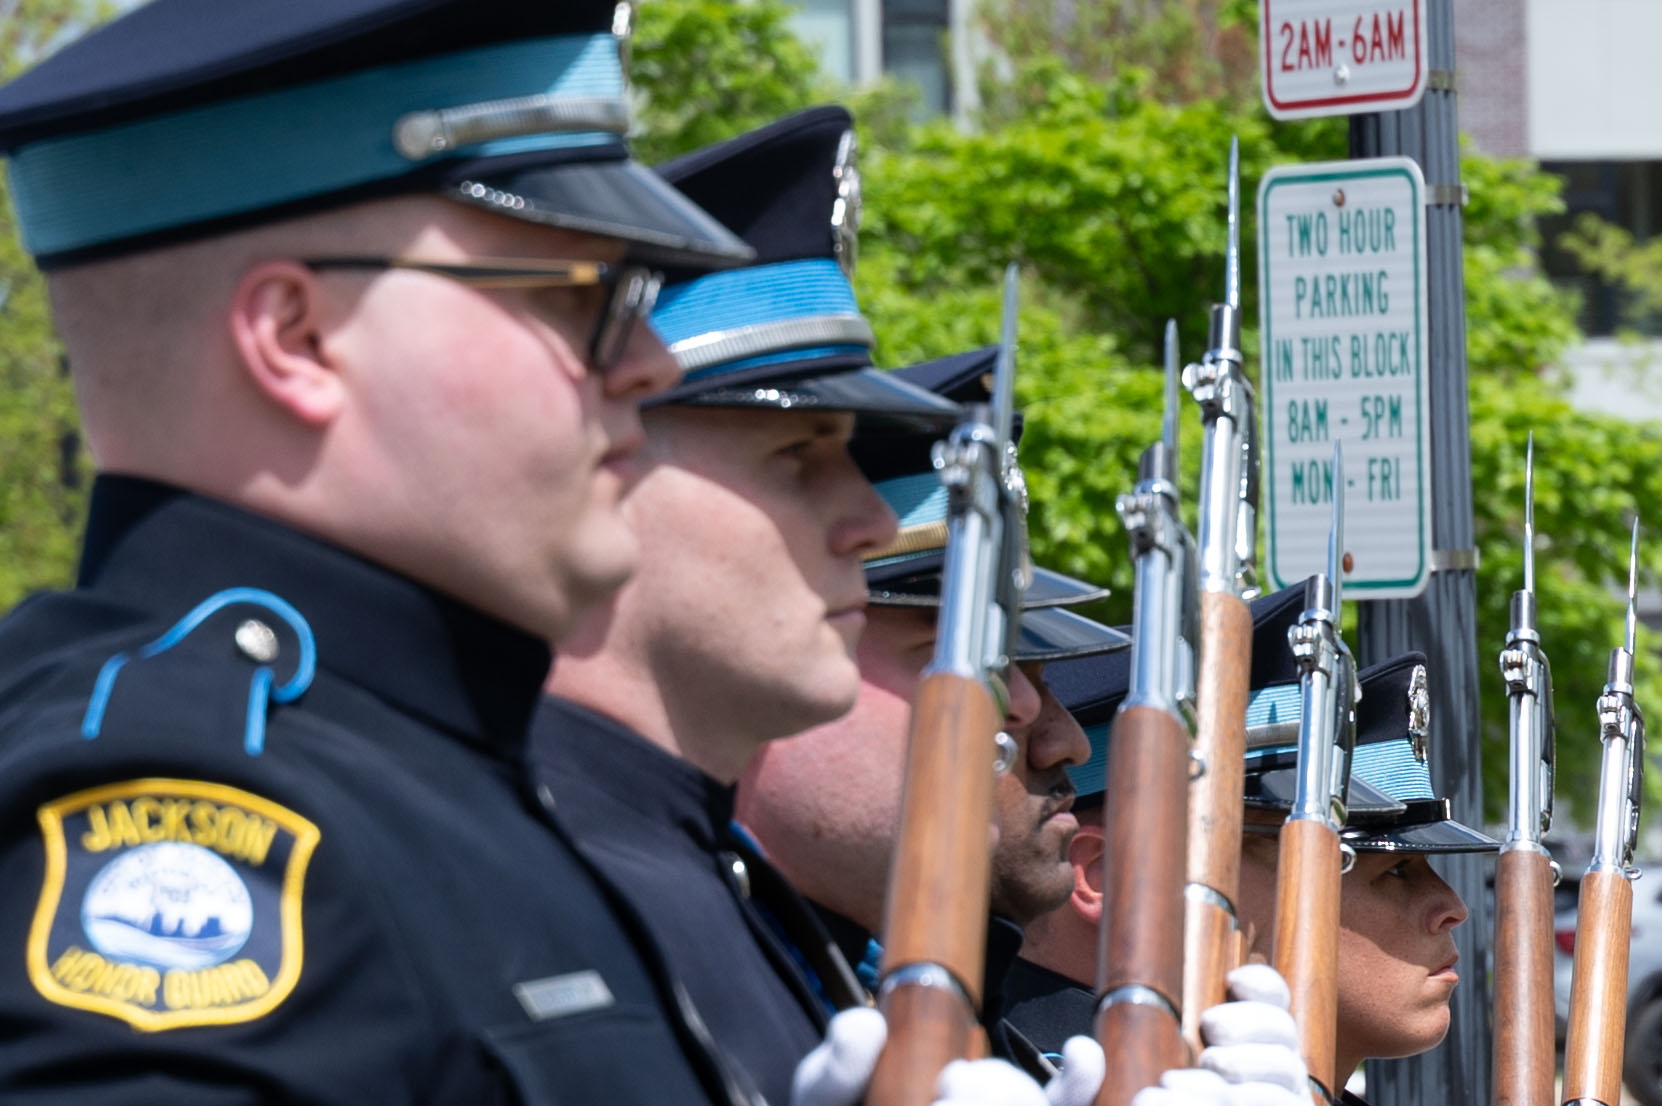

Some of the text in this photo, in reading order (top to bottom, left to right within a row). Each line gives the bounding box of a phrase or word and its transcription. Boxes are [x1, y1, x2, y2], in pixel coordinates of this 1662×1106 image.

[1286, 207, 1396, 257] TWO HOUR
[1295, 269, 1390, 319] PARKING
[1275, 331, 1412, 382] IN THIS BLOCK
[1287, 398, 1329, 443] 8AM
[1360, 394, 1403, 439] 5PM
[1291, 460, 1334, 505] MON
[1368, 457, 1401, 502] FRI
[81, 798, 278, 866] JACKSON
